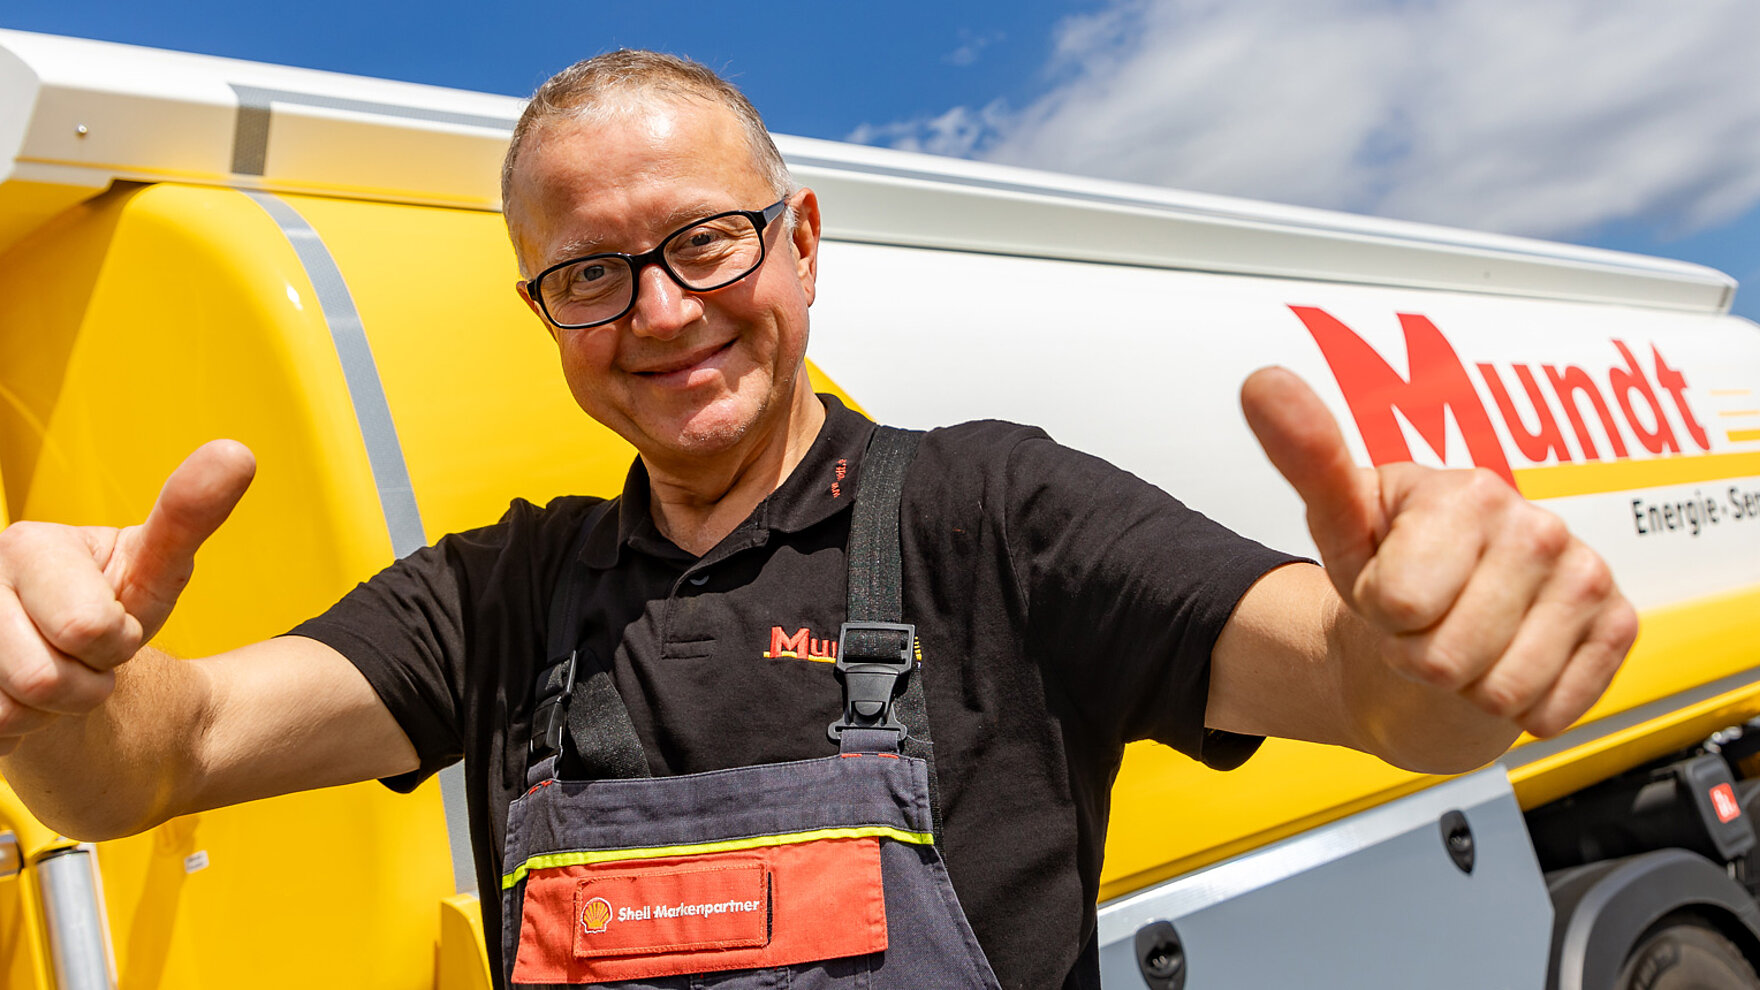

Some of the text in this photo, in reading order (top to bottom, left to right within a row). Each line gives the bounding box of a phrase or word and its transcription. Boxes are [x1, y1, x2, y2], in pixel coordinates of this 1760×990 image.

[1286, 304, 1711, 499] Mundt
[617, 899, 760, 923] Shell Markenpartner
